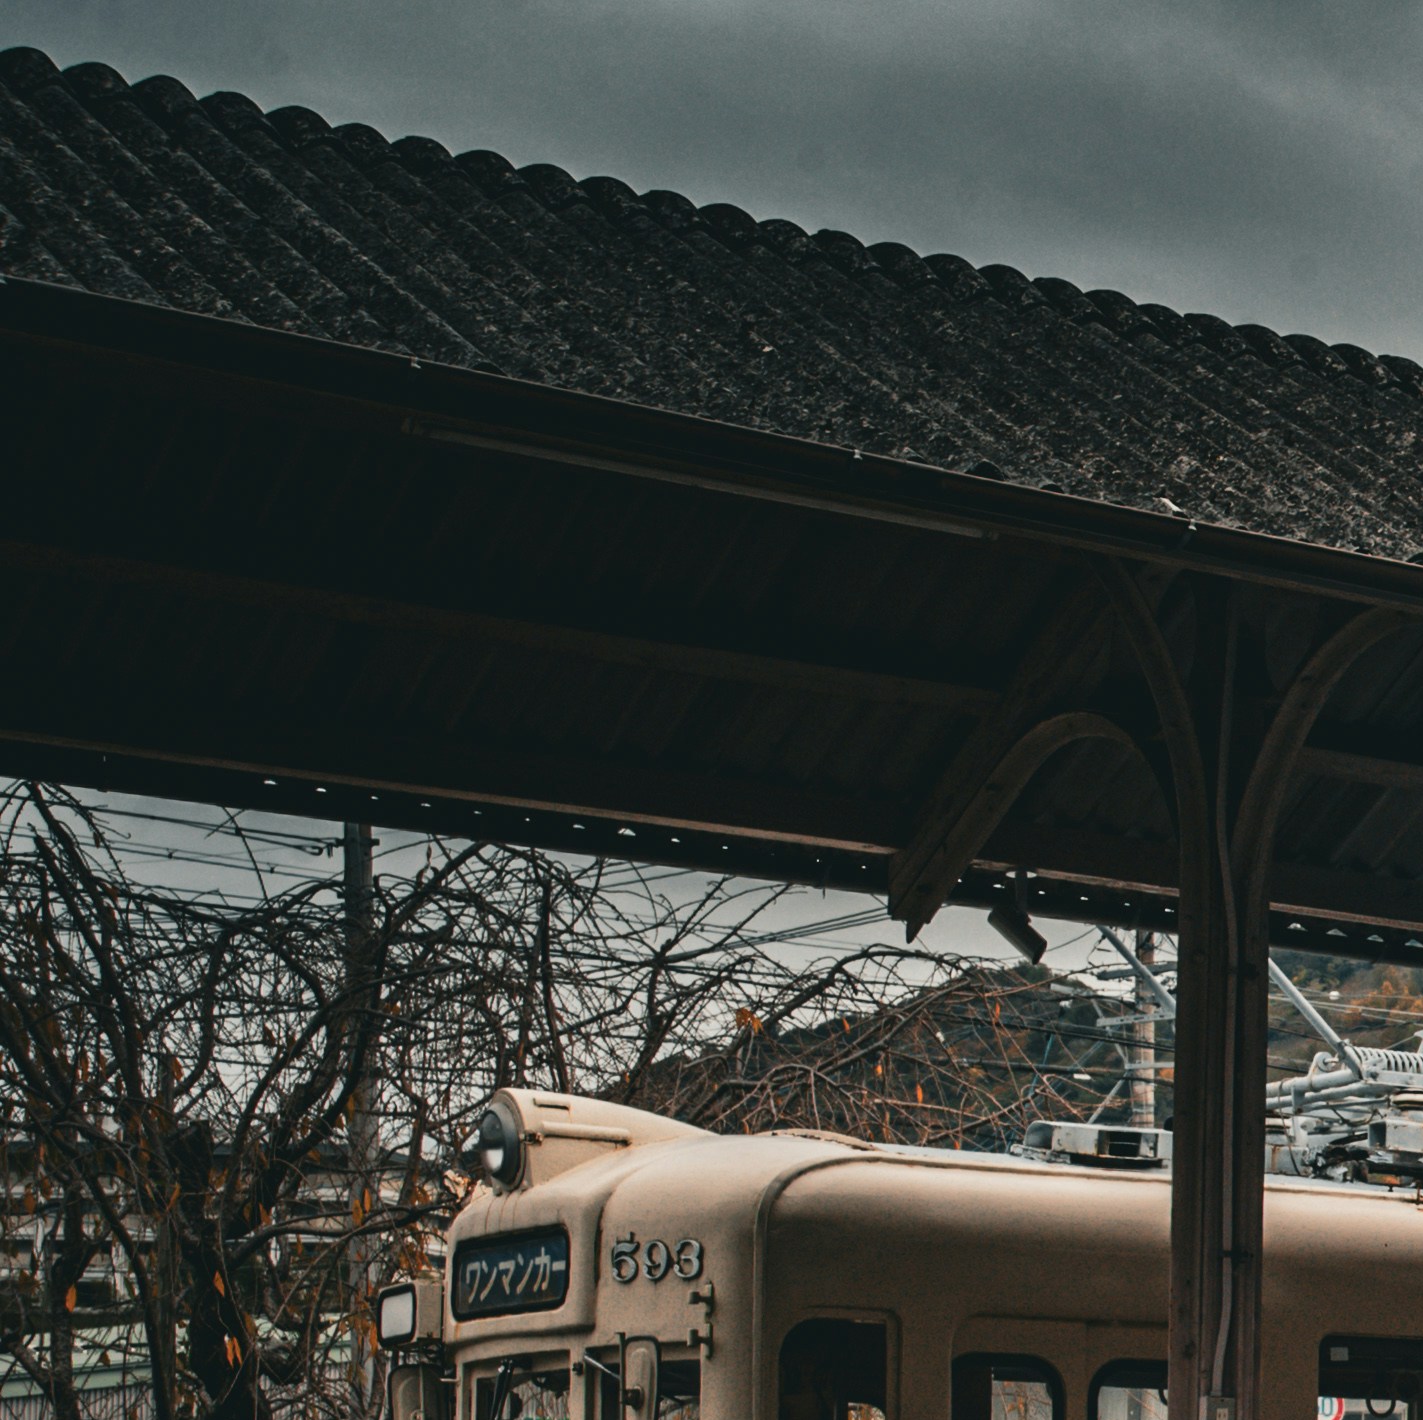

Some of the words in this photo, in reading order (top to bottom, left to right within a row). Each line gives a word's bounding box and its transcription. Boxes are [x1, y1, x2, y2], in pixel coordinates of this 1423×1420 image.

[464, 1246, 567, 1306] ワンマンカー
[610, 1235, 704, 1284] 593
